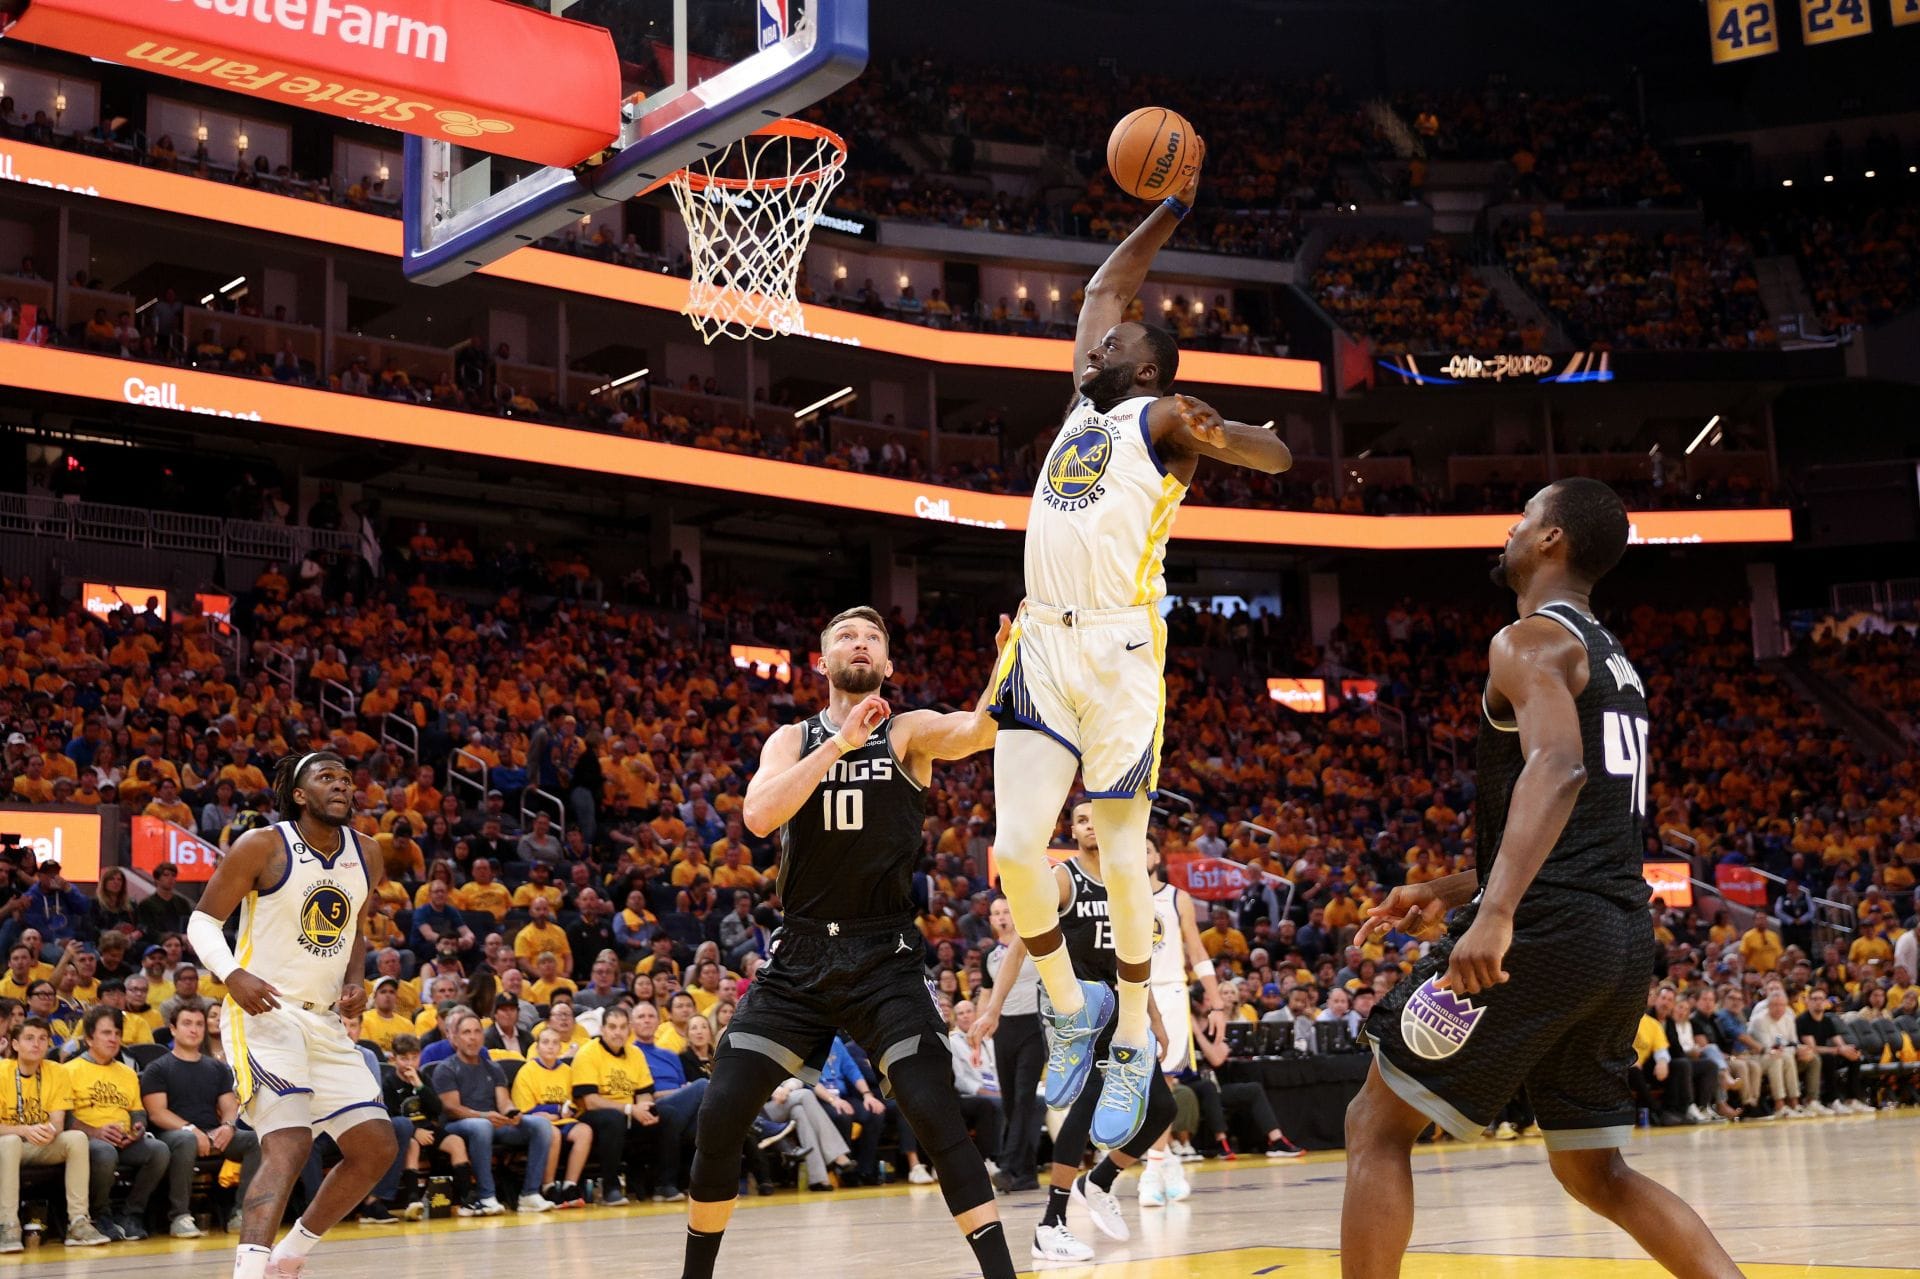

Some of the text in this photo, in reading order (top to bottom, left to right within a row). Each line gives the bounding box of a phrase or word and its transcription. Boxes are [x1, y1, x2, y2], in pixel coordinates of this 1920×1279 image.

[1717, 3, 1772, 49] 42
[1804, 0, 1864, 33] 24
[168, 0, 448, 63] ateFarm
[762, 23, 777, 50] NBA
[1144, 132, 1180, 189] Wilson
[1063, 417, 1122, 441] GOLDEN STATE
[1080, 443, 1107, 462] 23
[821, 758, 893, 783] NGS
[823, 788, 863, 830] 10
[331, 902, 342, 919] 5
[1076, 900, 1109, 918] KIN
[297, 934, 346, 958] WARRIORS
[1094, 921, 1116, 949] 13
[1406, 996, 1467, 1045] KINGS
[1419, 990, 1470, 1029] SACRAMENTO
